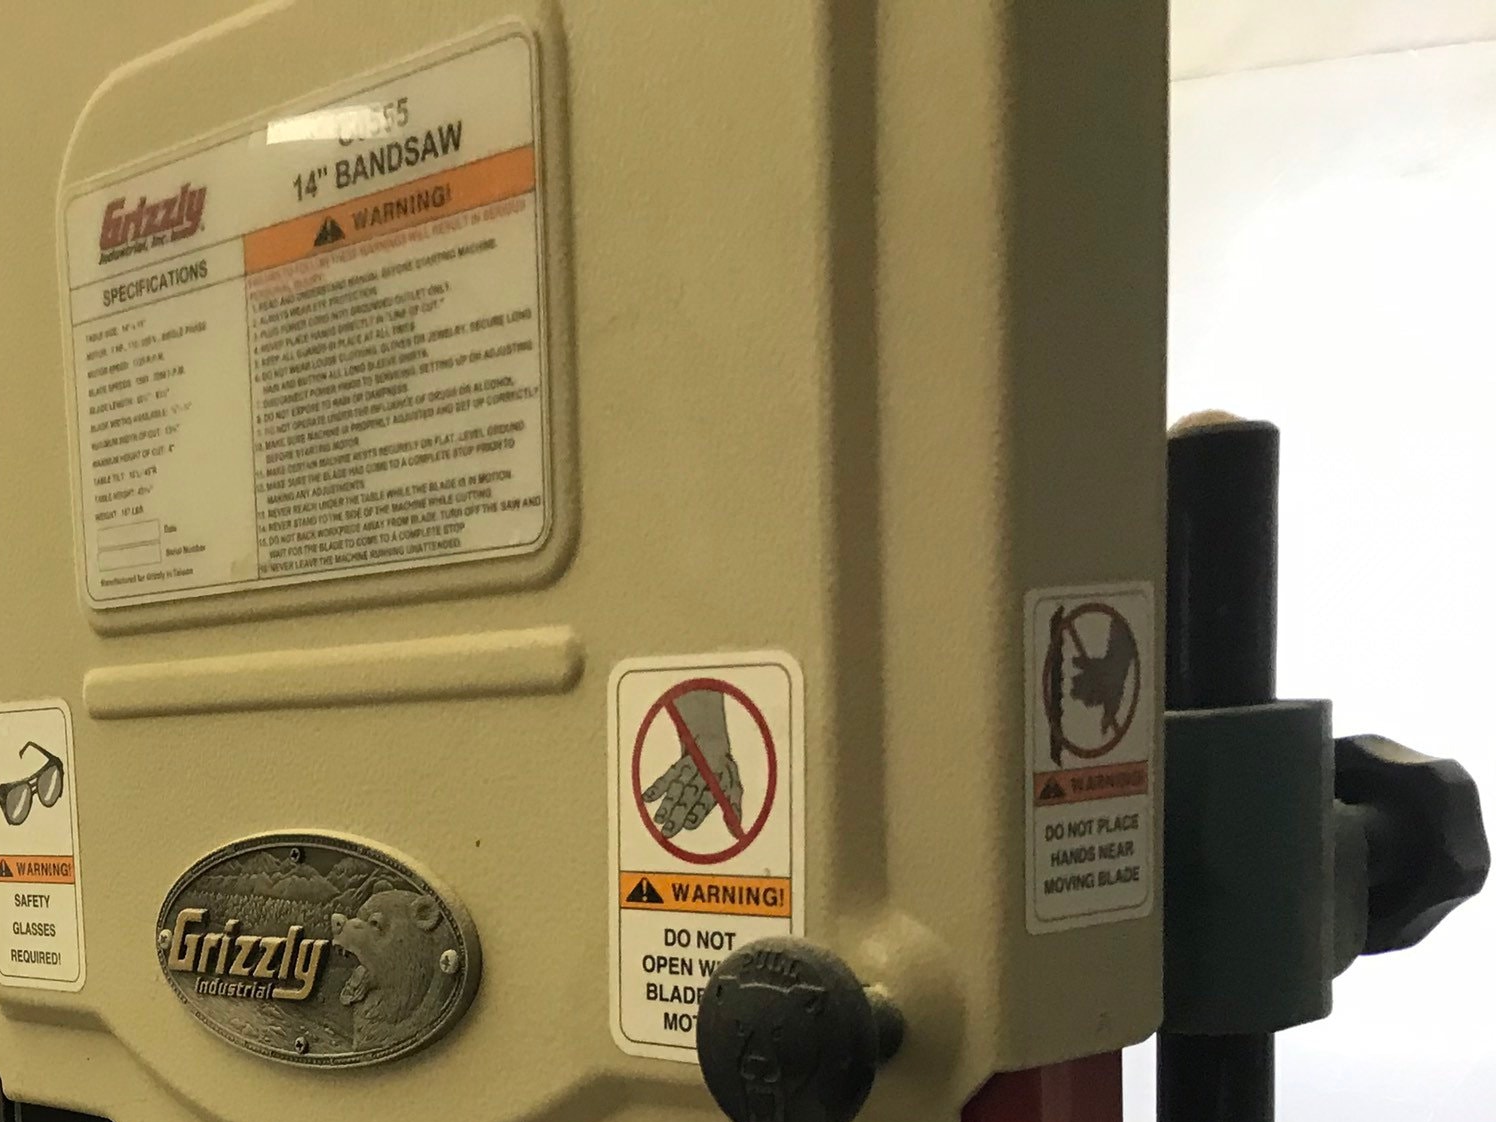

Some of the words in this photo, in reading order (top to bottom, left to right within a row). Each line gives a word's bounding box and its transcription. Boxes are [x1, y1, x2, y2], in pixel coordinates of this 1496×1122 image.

[293, 166, 327, 201] 14"
[336, 121, 462, 189] BANDSAW
[100, 182, 207, 250] Grizzly
[354, 184, 453, 230] WARNING!
[103, 259, 208, 307] SPECIFICATIONS
[1045, 821, 1065, 842] DO
[1068, 818, 1095, 838] NOT
[1096, 813, 1140, 834] PLACE
[1050, 846, 1096, 867] HANDS
[1099, 840, 1135, 859] NEAR
[16, 861, 72, 877] WARNING!
[1044, 872, 1096, 895] MOVING
[1098, 865, 1141, 887] BLADE
[14, 894, 50, 908] SAFETY
[672, 883, 785, 907] WARNING!
[12, 921, 56, 937] GLASSES
[664, 928, 691, 948] DO
[696, 930, 736, 951] NOT
[11, 948, 61, 965] REQUIRED!
[168, 908, 329, 1000] Grizzly
[642, 954, 693, 976] OPEN
[699, 960, 722, 978] W
[195, 976, 274, 1000] Industrial
[664, 1012, 698, 1032] MO
